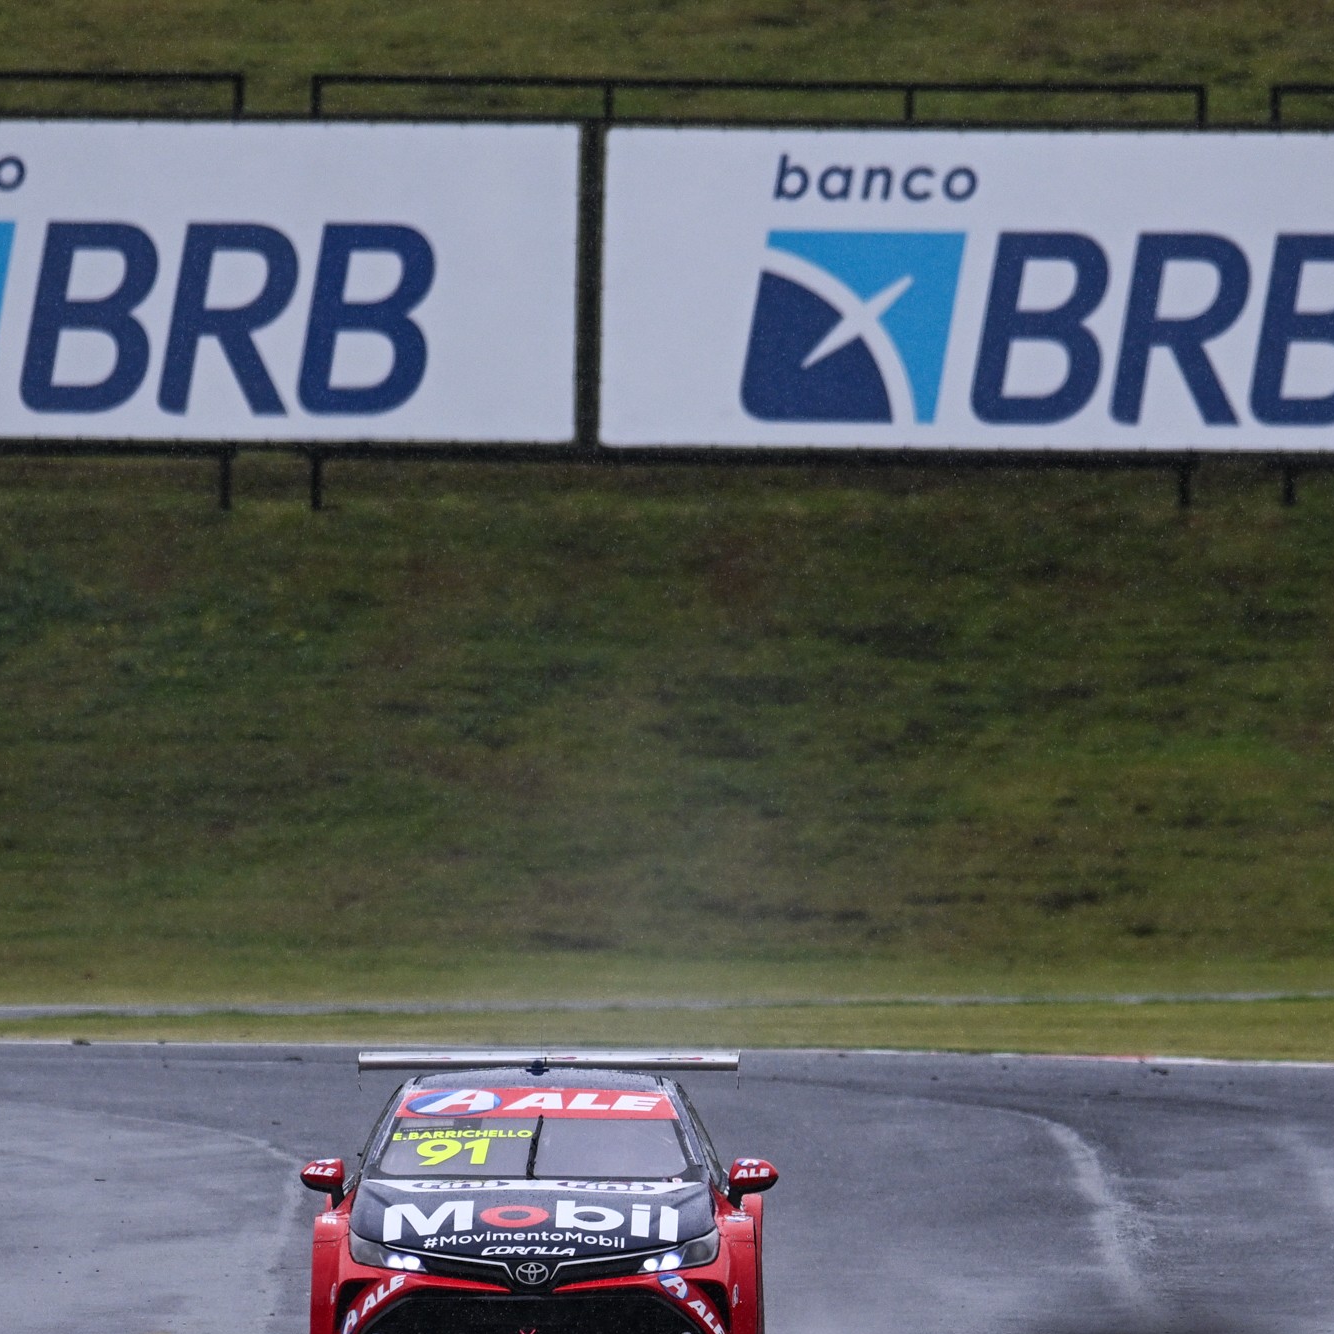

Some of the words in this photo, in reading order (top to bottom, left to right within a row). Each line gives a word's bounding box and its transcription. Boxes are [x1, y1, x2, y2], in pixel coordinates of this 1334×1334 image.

[772, 154, 979, 202] banco
[19, 221, 436, 417] BRB
[502, 1092, 662, 1112] ALE
[392, 1129, 533, 1141] E.BARRICHELLO
[416, 1138, 491, 1166] 91
[303, 1166, 337, 1177] ALE
[734, 1168, 770, 1179] ALE
[382, 1200, 679, 1243] Mobil
[424, 1231, 625, 1249] #MovimentoMobil
[480, 1245, 576, 1257] COROLLA
[361, 1275, 407, 1317] ALE
